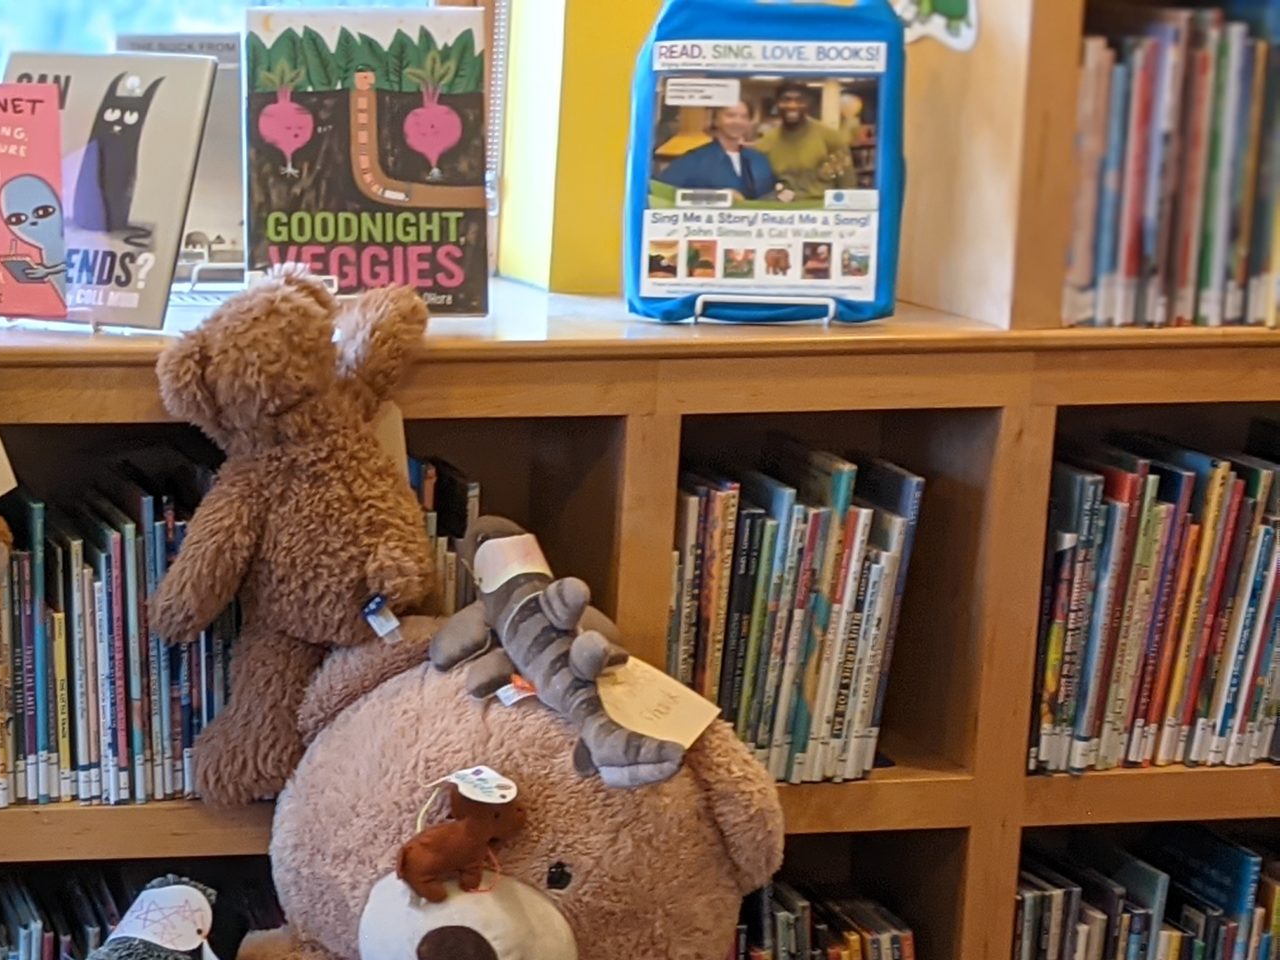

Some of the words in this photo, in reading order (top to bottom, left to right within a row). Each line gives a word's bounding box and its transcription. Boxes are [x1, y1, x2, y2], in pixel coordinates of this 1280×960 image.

[658, 44, 707, 60] READ.
[711, 45, 754, 60] SING.
[761, 45, 810, 61] LOVE.
[815, 46, 882, 62] BOOKS!
[651, 212, 679, 225] Sing
[840, 612, 863, 684] BLUEBERRIES
[836, 688, 849, 710] FOR
